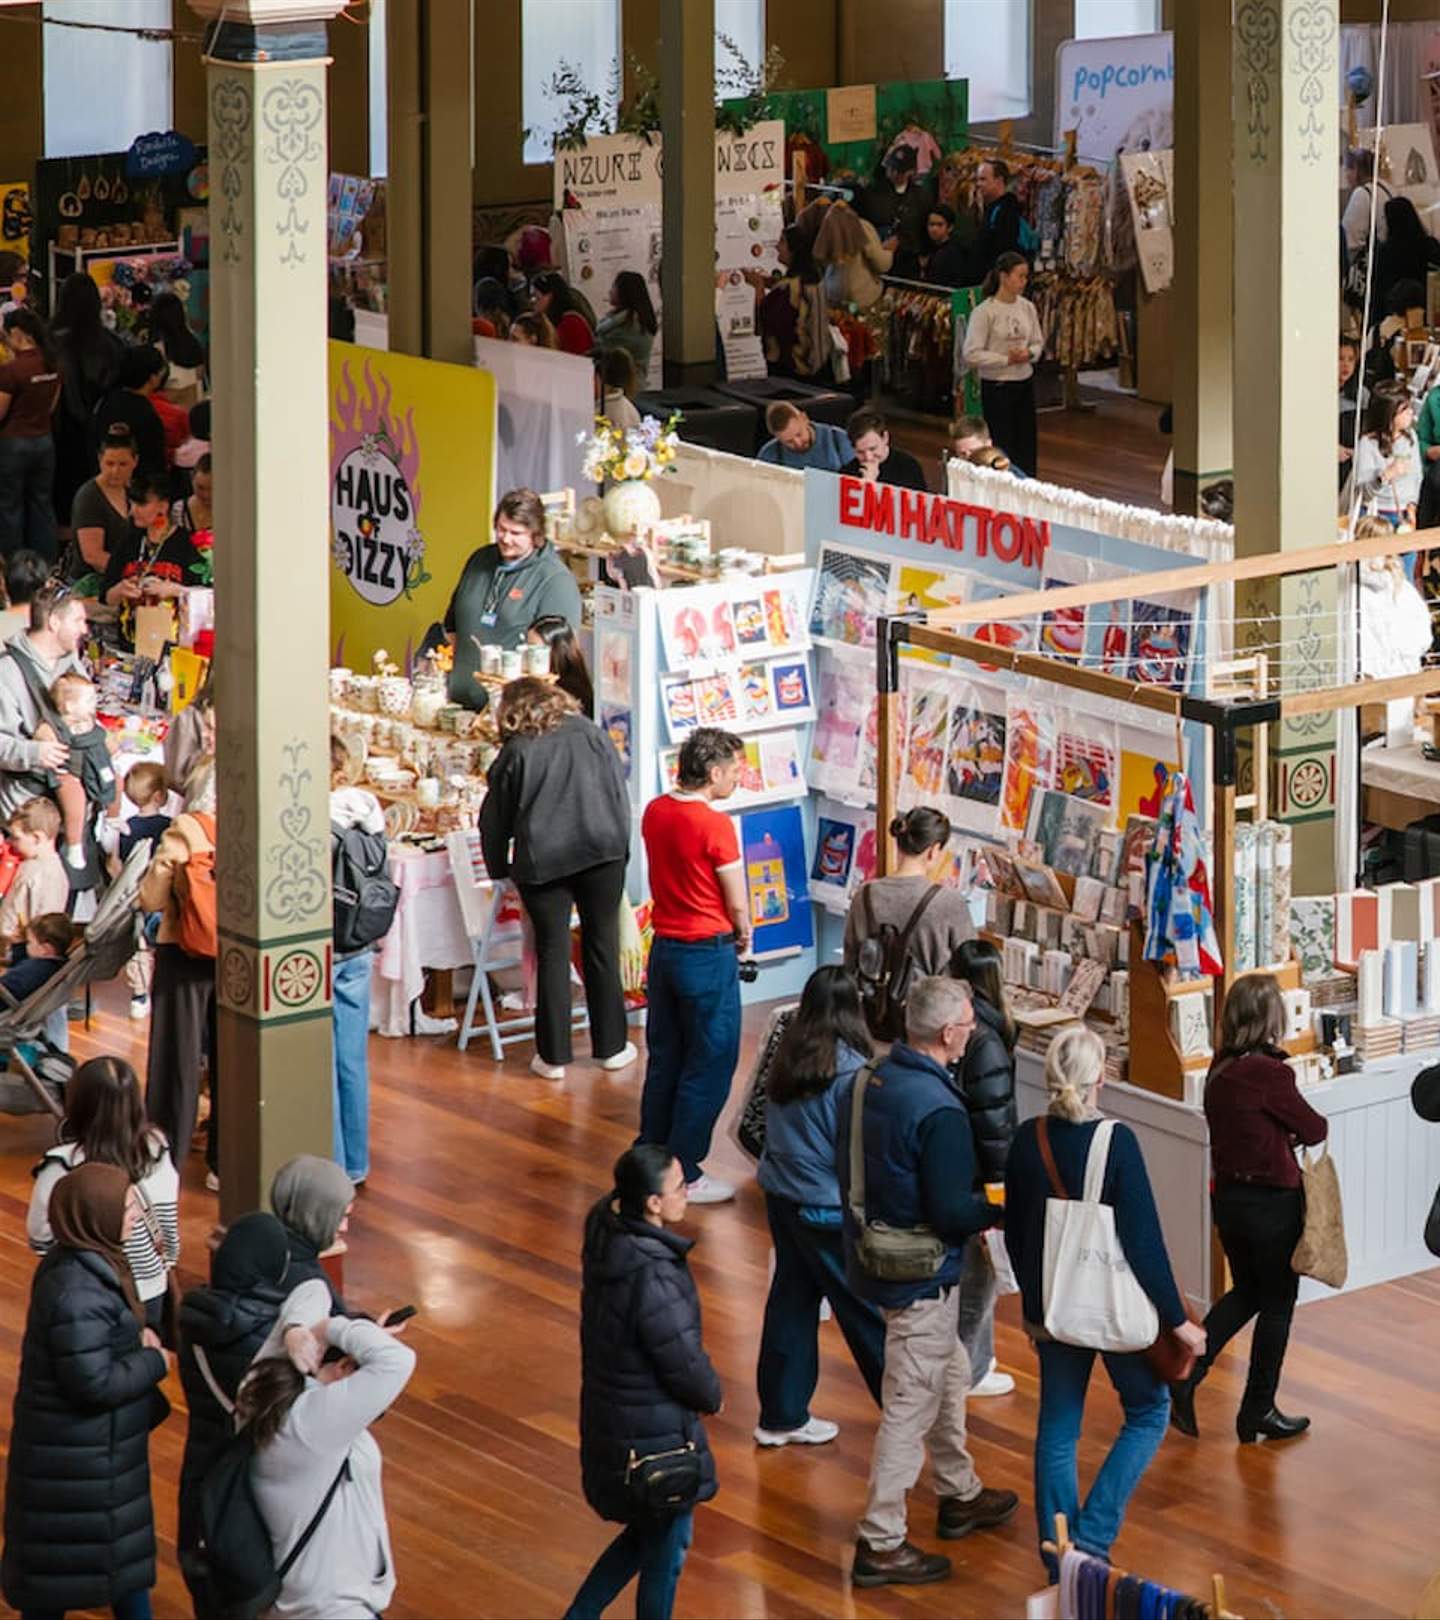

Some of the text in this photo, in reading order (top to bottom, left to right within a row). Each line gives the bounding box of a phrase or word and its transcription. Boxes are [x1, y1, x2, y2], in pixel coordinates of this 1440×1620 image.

[336, 465, 410, 522] HAUS
[839, 473, 1050, 571] EM HATTON
[337, 530, 412, 590] DIZZY
